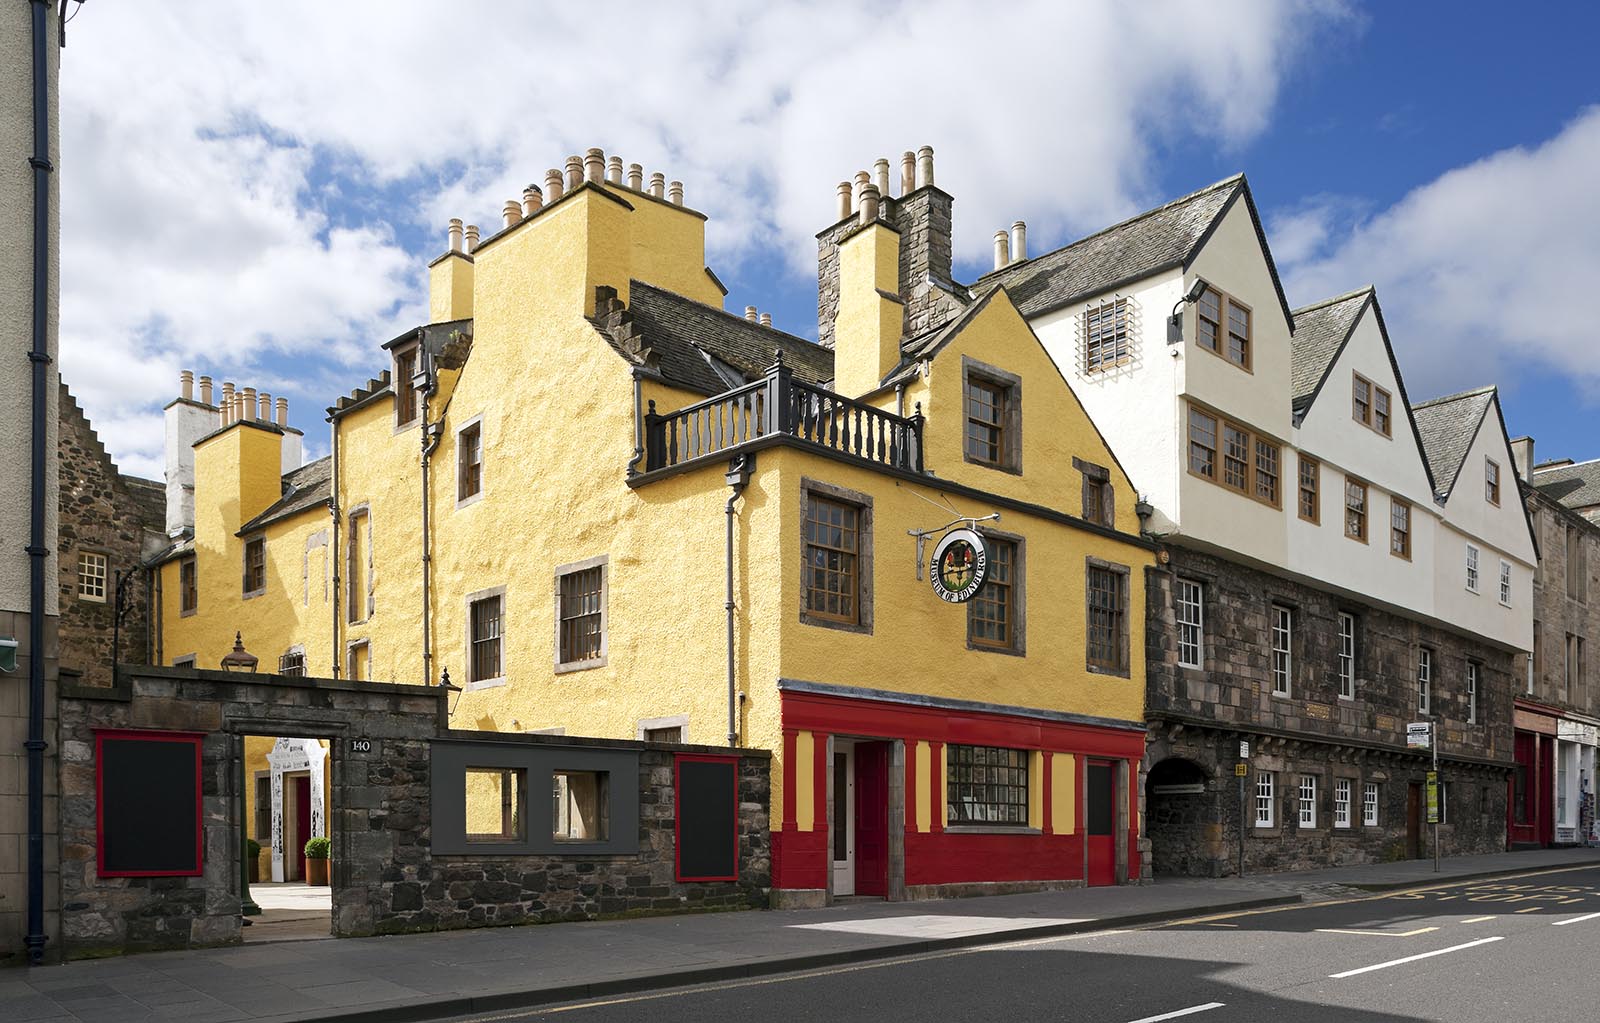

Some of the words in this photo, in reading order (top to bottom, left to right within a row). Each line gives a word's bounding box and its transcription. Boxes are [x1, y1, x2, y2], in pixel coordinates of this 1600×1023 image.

[931, 559, 946, 597] MUSEUM
[945, 592, 954, 602] OF
[958, 550, 985, 601] EDINBURGH
[352, 740, 370, 751] 140
[1465, 884, 1595, 893] BUS
[1390, 891, 1569, 903] STOP
